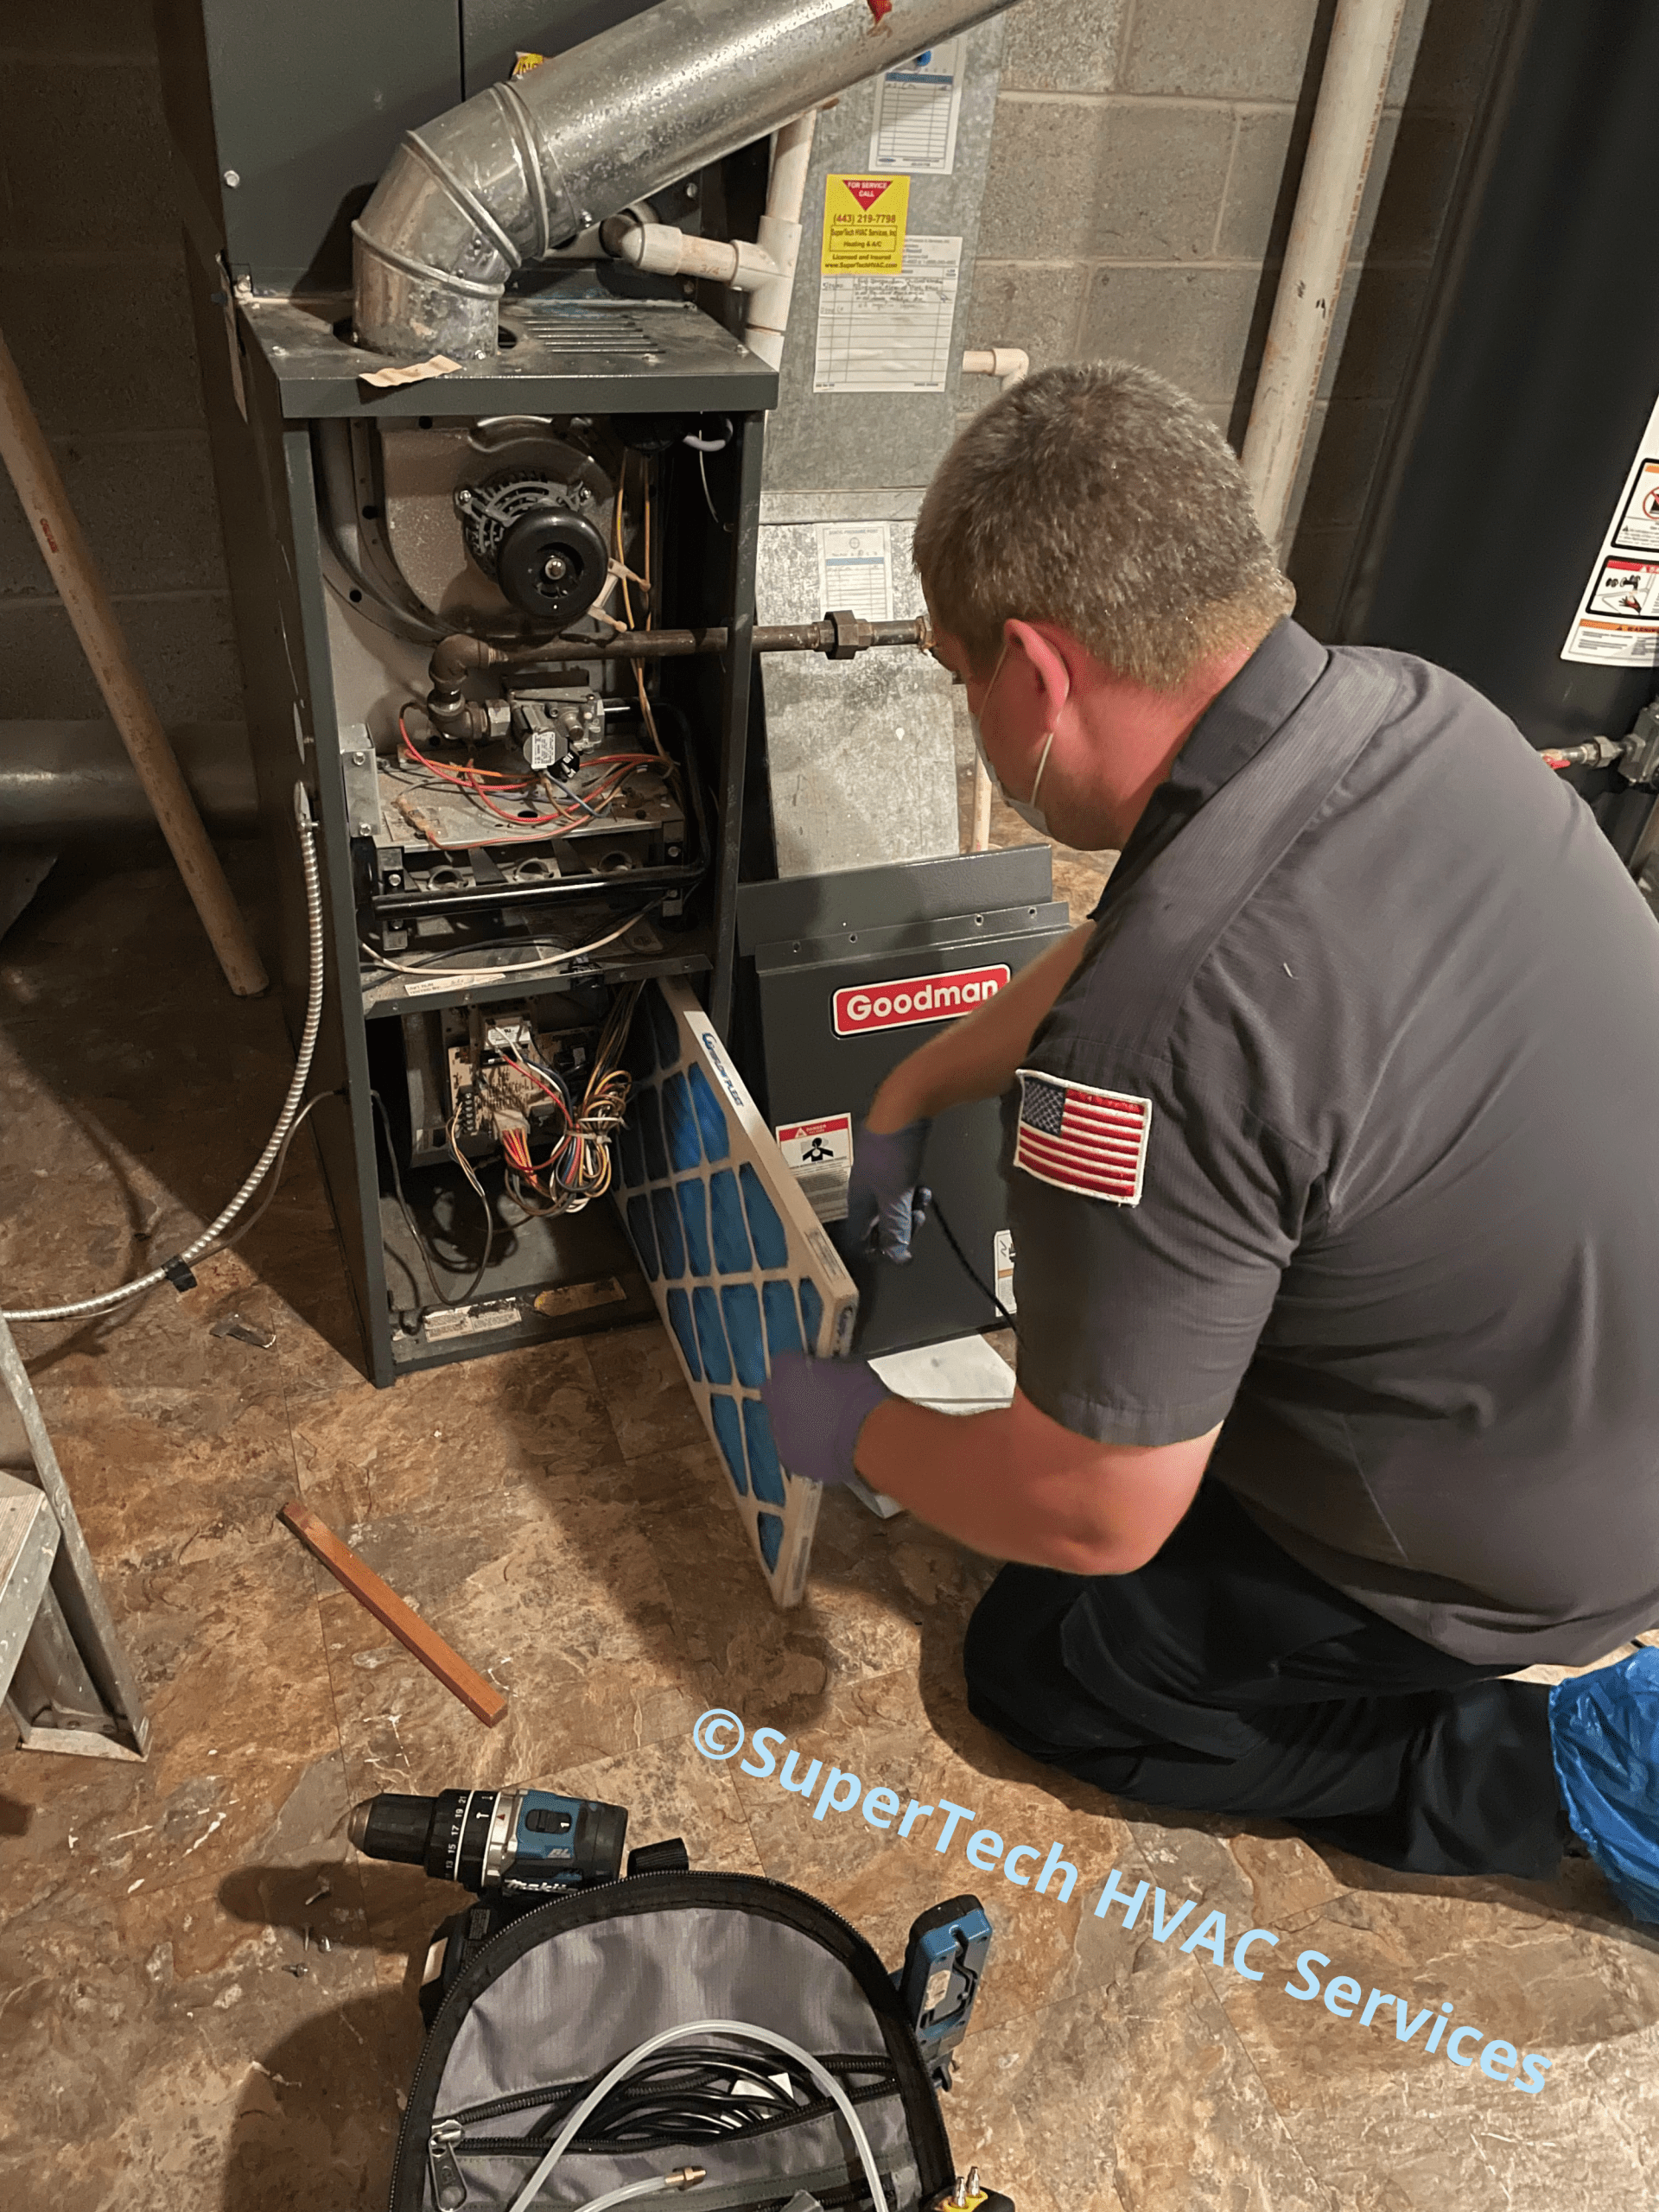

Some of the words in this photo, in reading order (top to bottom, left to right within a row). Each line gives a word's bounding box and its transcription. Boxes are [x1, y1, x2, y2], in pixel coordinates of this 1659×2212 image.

[858, 189, 875, 198] CALL
[847, 979, 999, 1021] Goodman
[458, 1796, 467, 1804] 21
[454, 1808, 464, 1818] 19
[451, 1825, 460, 1836] 17
[448, 1843, 456, 1854] 15
[445, 1859, 454, 1869] 13
